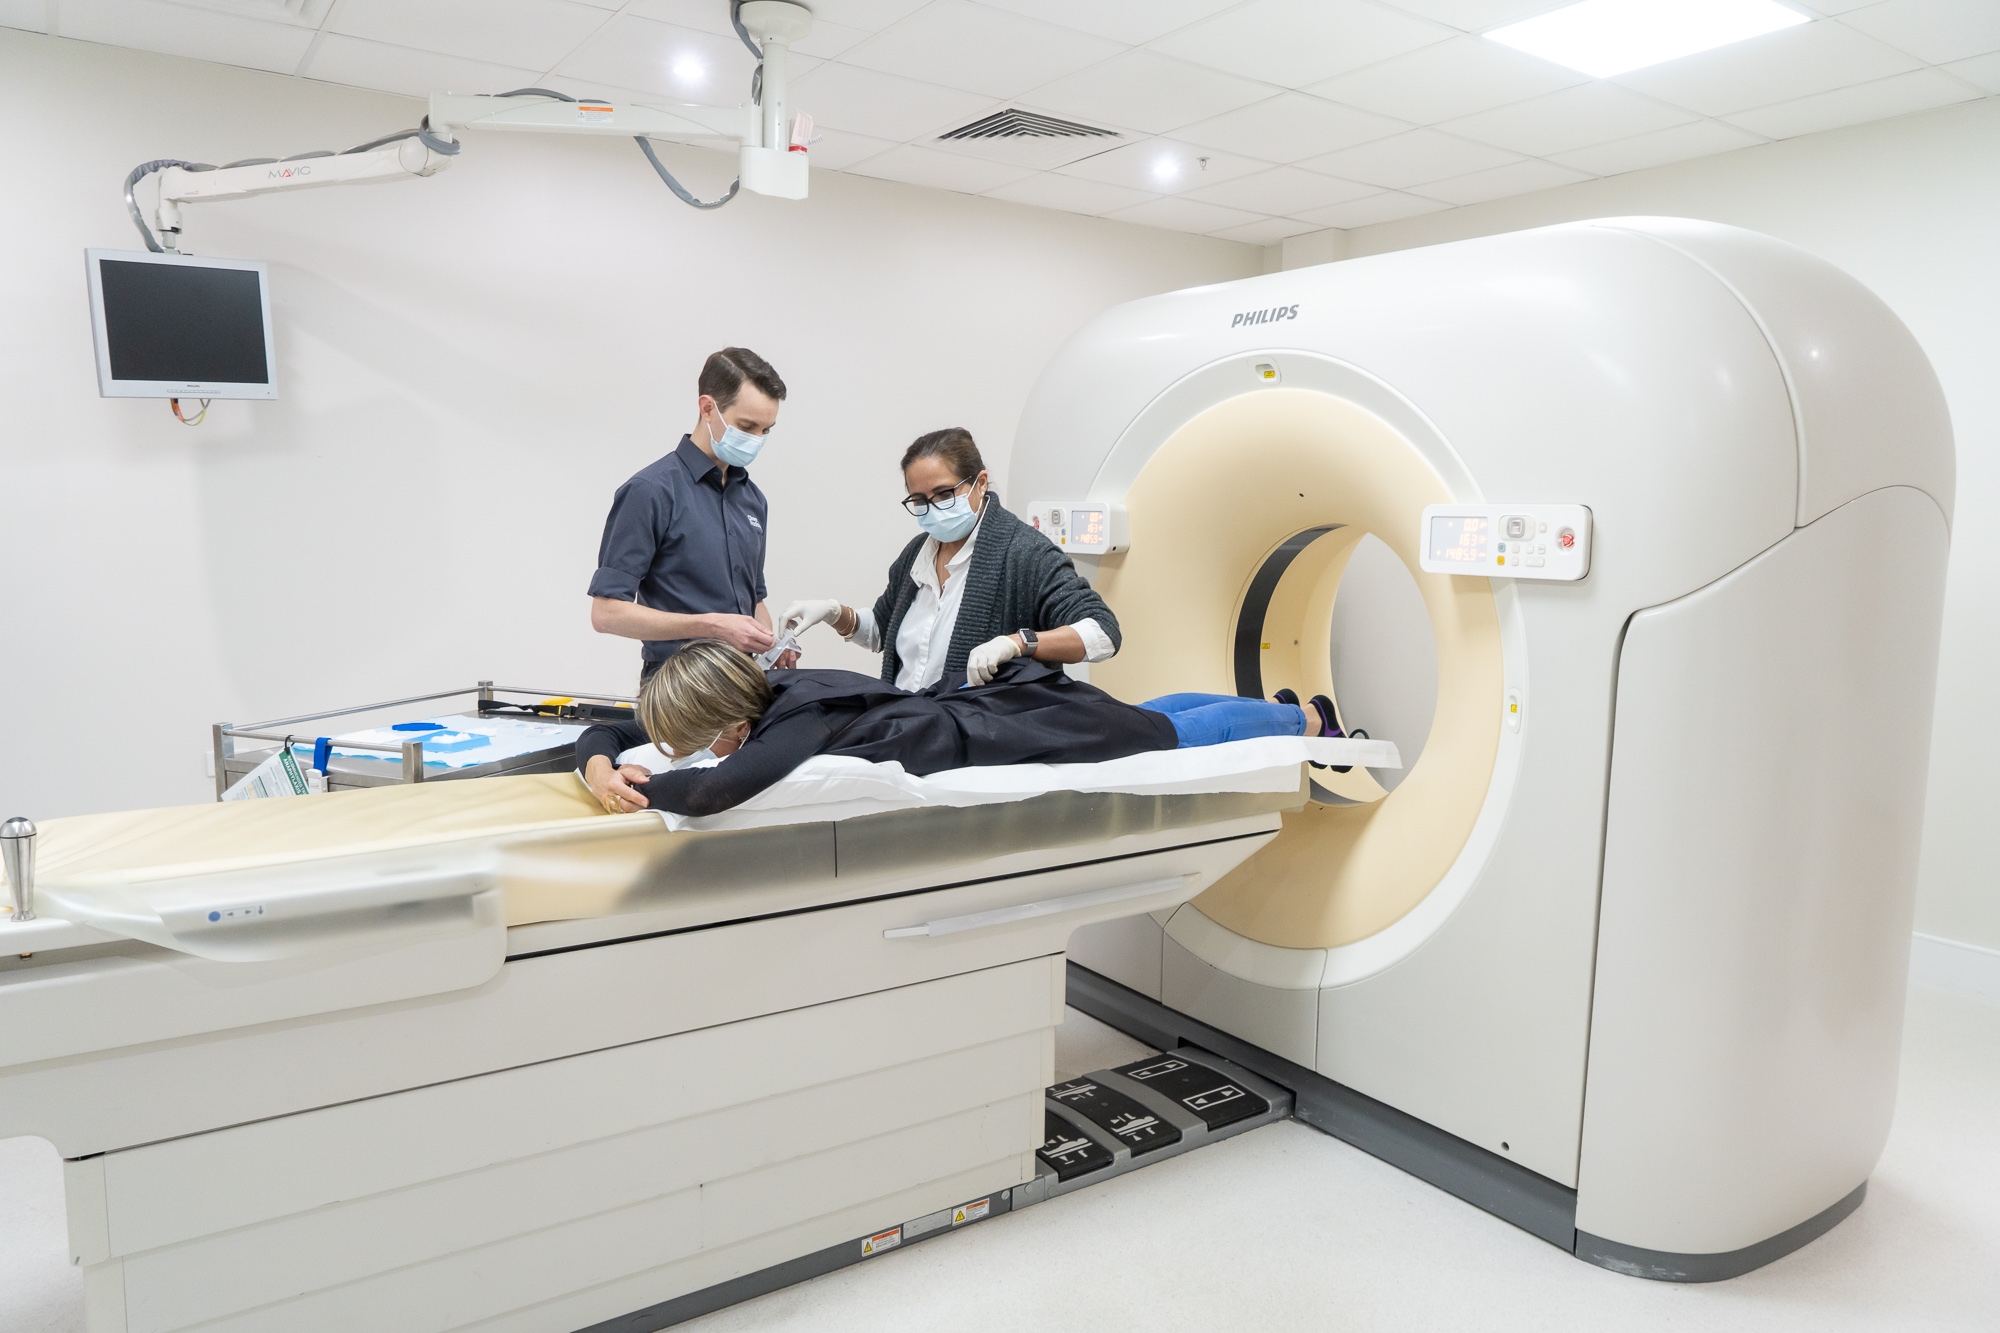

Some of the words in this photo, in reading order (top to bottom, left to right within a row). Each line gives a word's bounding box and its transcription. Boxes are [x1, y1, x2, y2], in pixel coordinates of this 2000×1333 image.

[1231, 304, 1300, 328] PHILIPS
[1459, 533, 1478, 547] 163
[1445, 547, 1478, 561] 1485.9
[283, 757, 301, 794] ANAPHYLAXIS
[287, 754, 304, 788] RECOMMENDED
